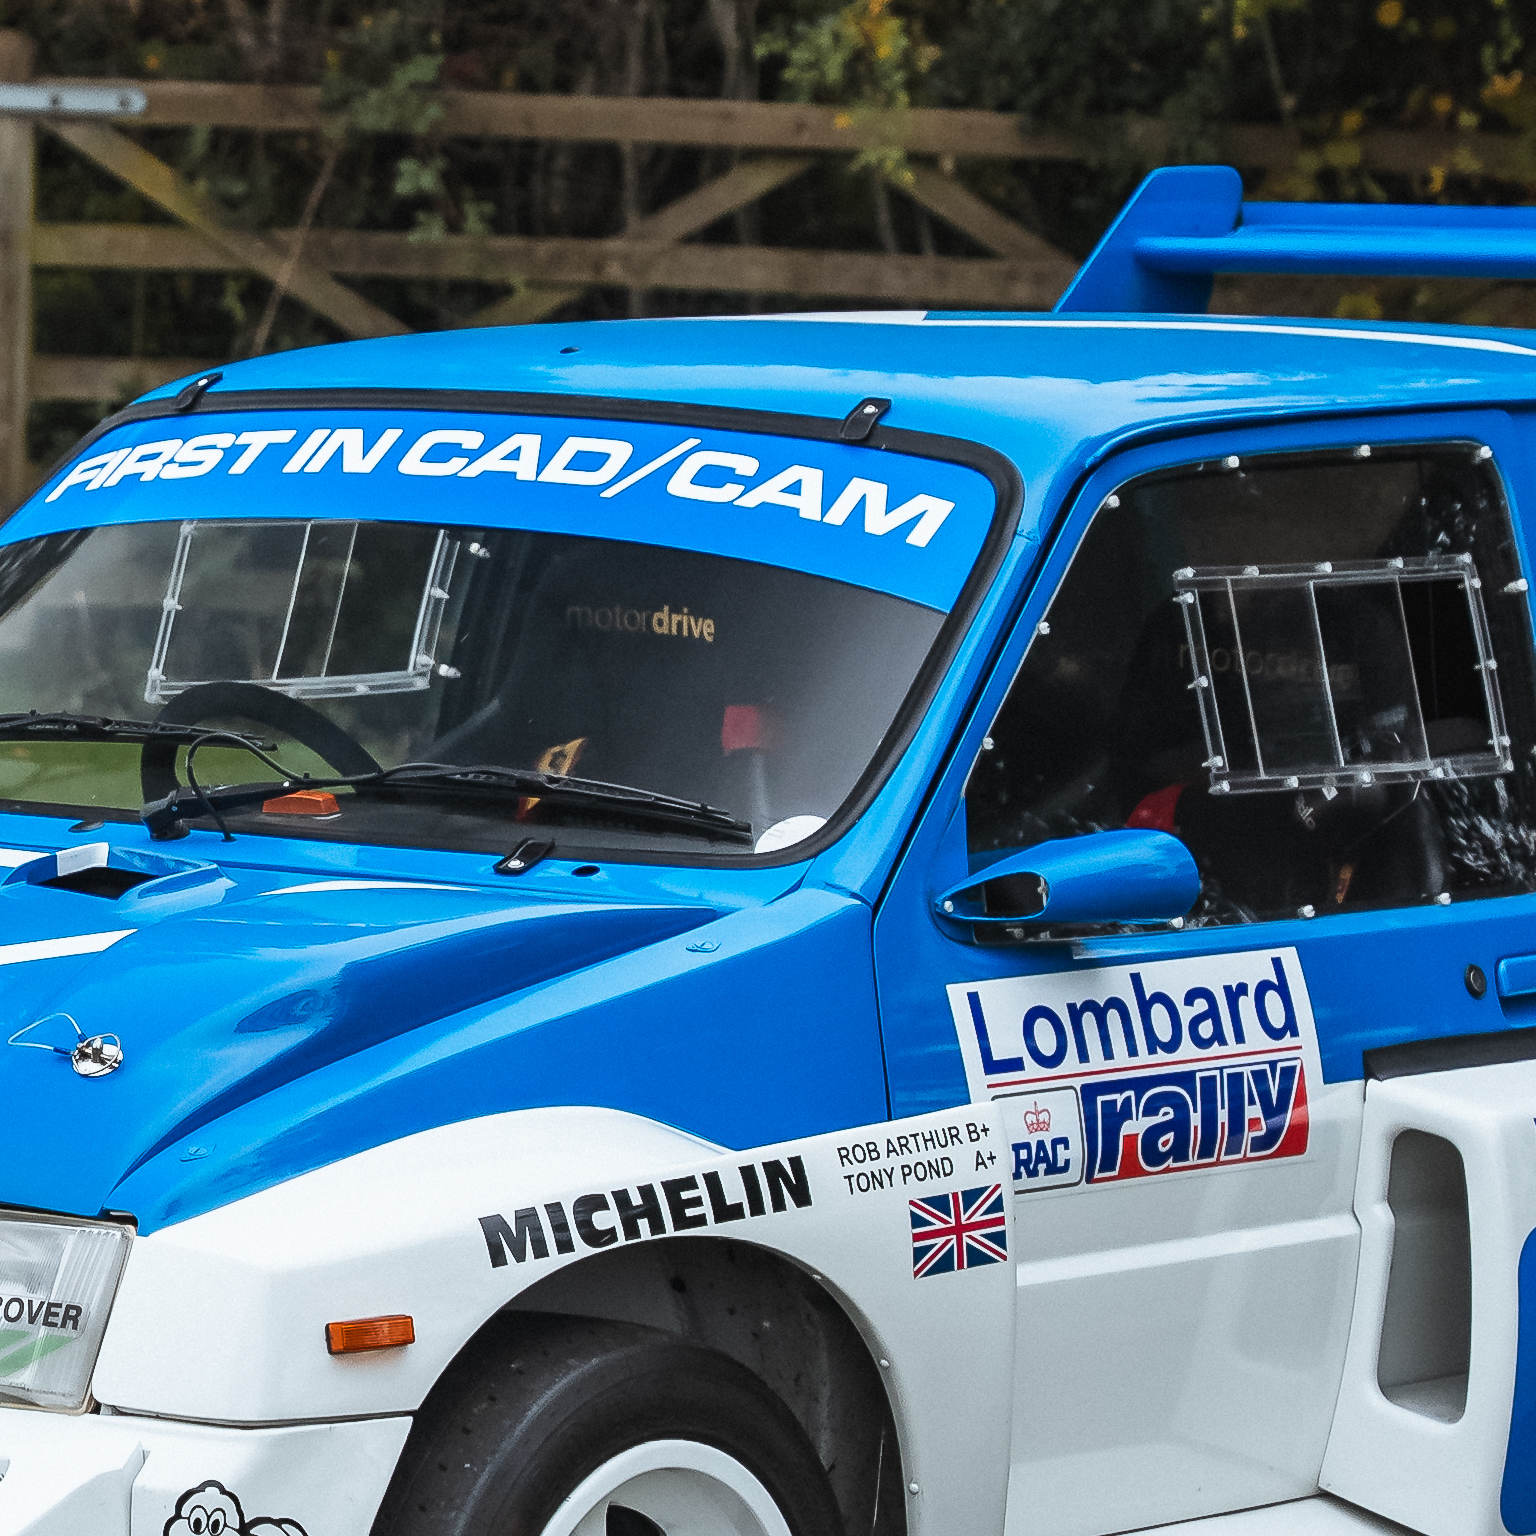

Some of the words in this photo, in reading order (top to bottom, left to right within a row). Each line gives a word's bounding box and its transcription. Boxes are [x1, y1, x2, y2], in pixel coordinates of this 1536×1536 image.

[45, 428, 297, 502] FIRST
[282, 428, 404, 474] IN
[398, 428, 955, 548] CAD/CAM
[566, 604, 715, 643] motordrive
[967, 956, 1299, 1076] Lombard
[837, 1141, 881, 1167] ROB
[885, 1126, 964, 1158] ARTHUR
[965, 1122, 991, 1142] B+
[1092, 1058, 1302, 1178] rally
[844, 1167, 895, 1195] TONY
[900, 1156, 954, 1185] POND
[974, 1150, 998, 1171] A+
[1011, 1136, 1070, 1181] RAC
[477, 1155, 813, 1268] MICHELIN
